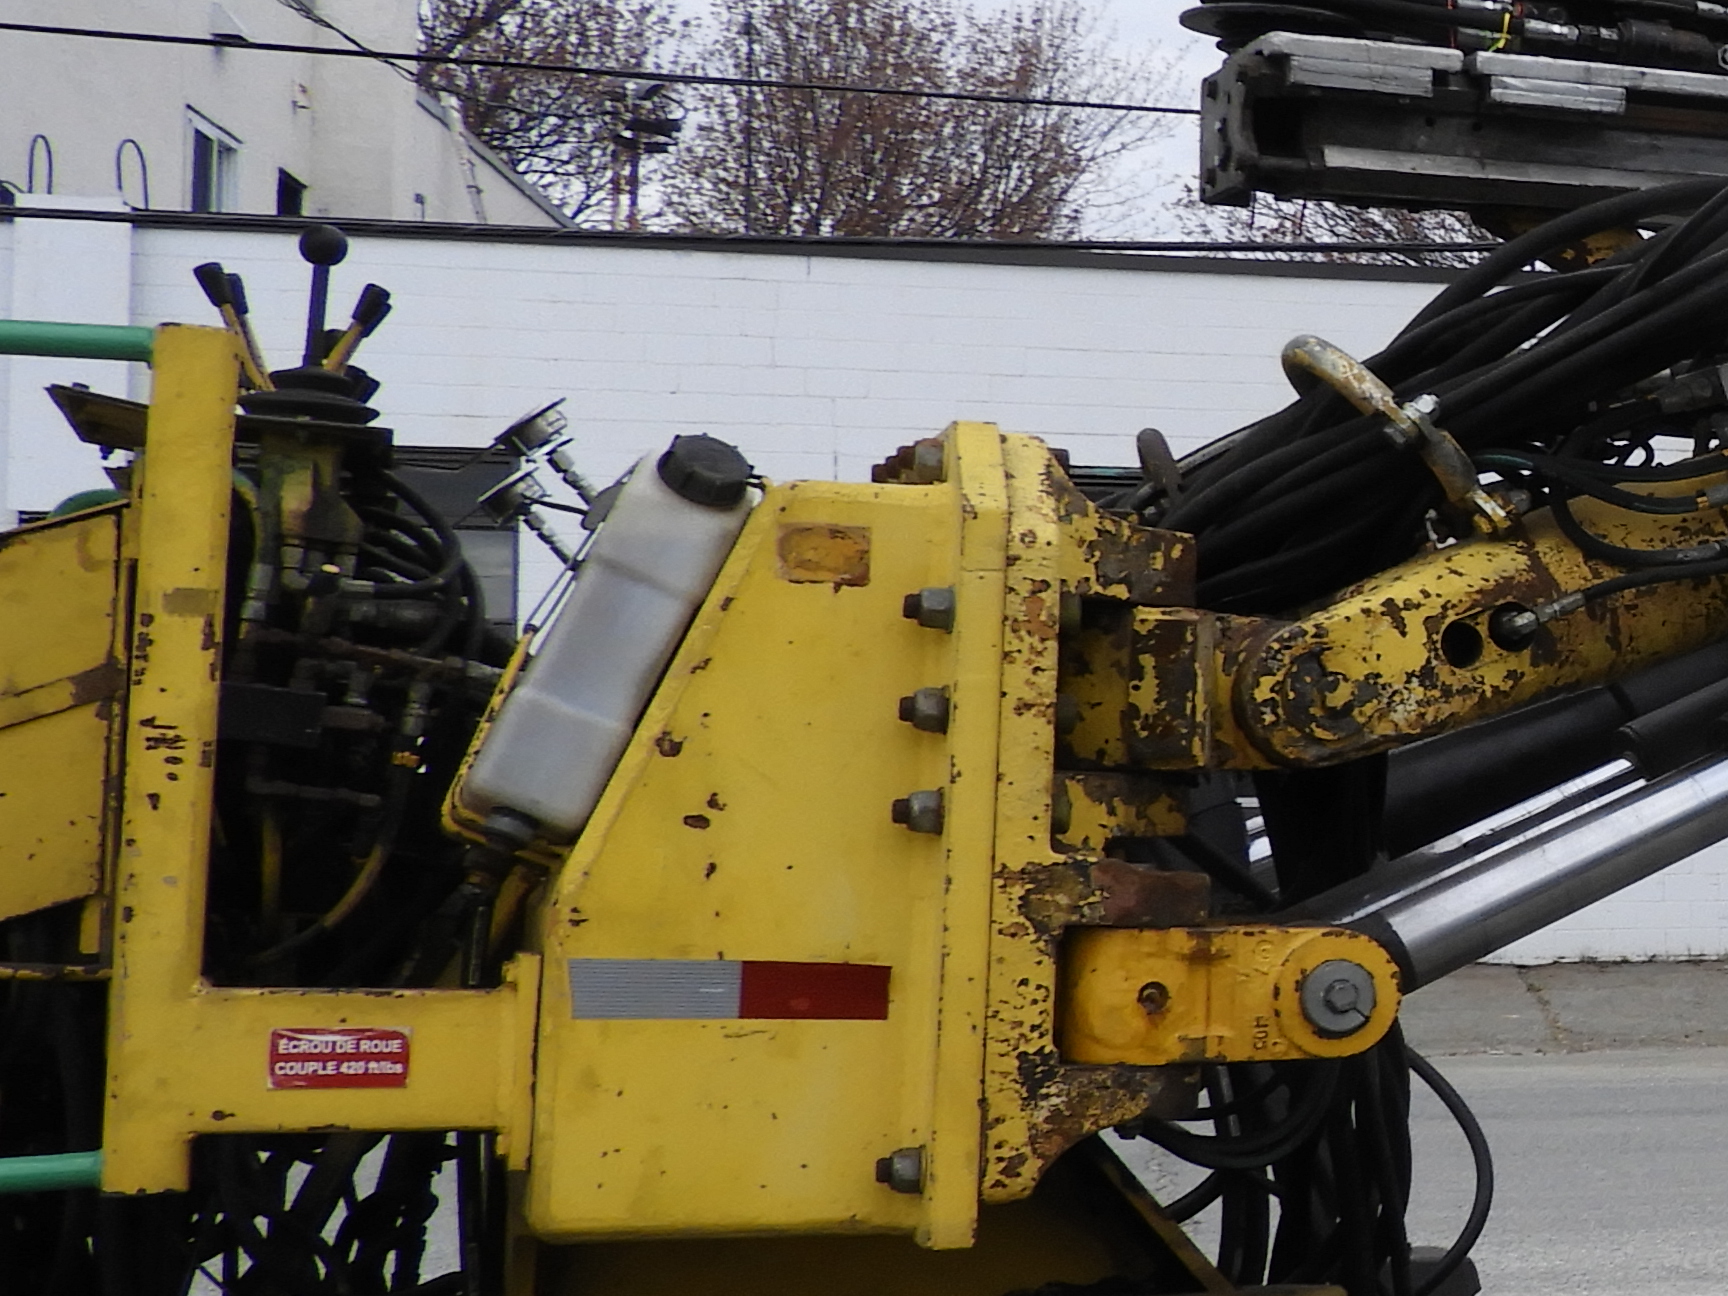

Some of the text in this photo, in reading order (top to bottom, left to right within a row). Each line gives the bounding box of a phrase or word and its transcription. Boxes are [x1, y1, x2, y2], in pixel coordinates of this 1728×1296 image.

[278, 1037, 403, 1054] ÉCROU DE ROUE
[274, 1061, 338, 1075] COUPLE
[339, 1061, 366, 1075] 420
